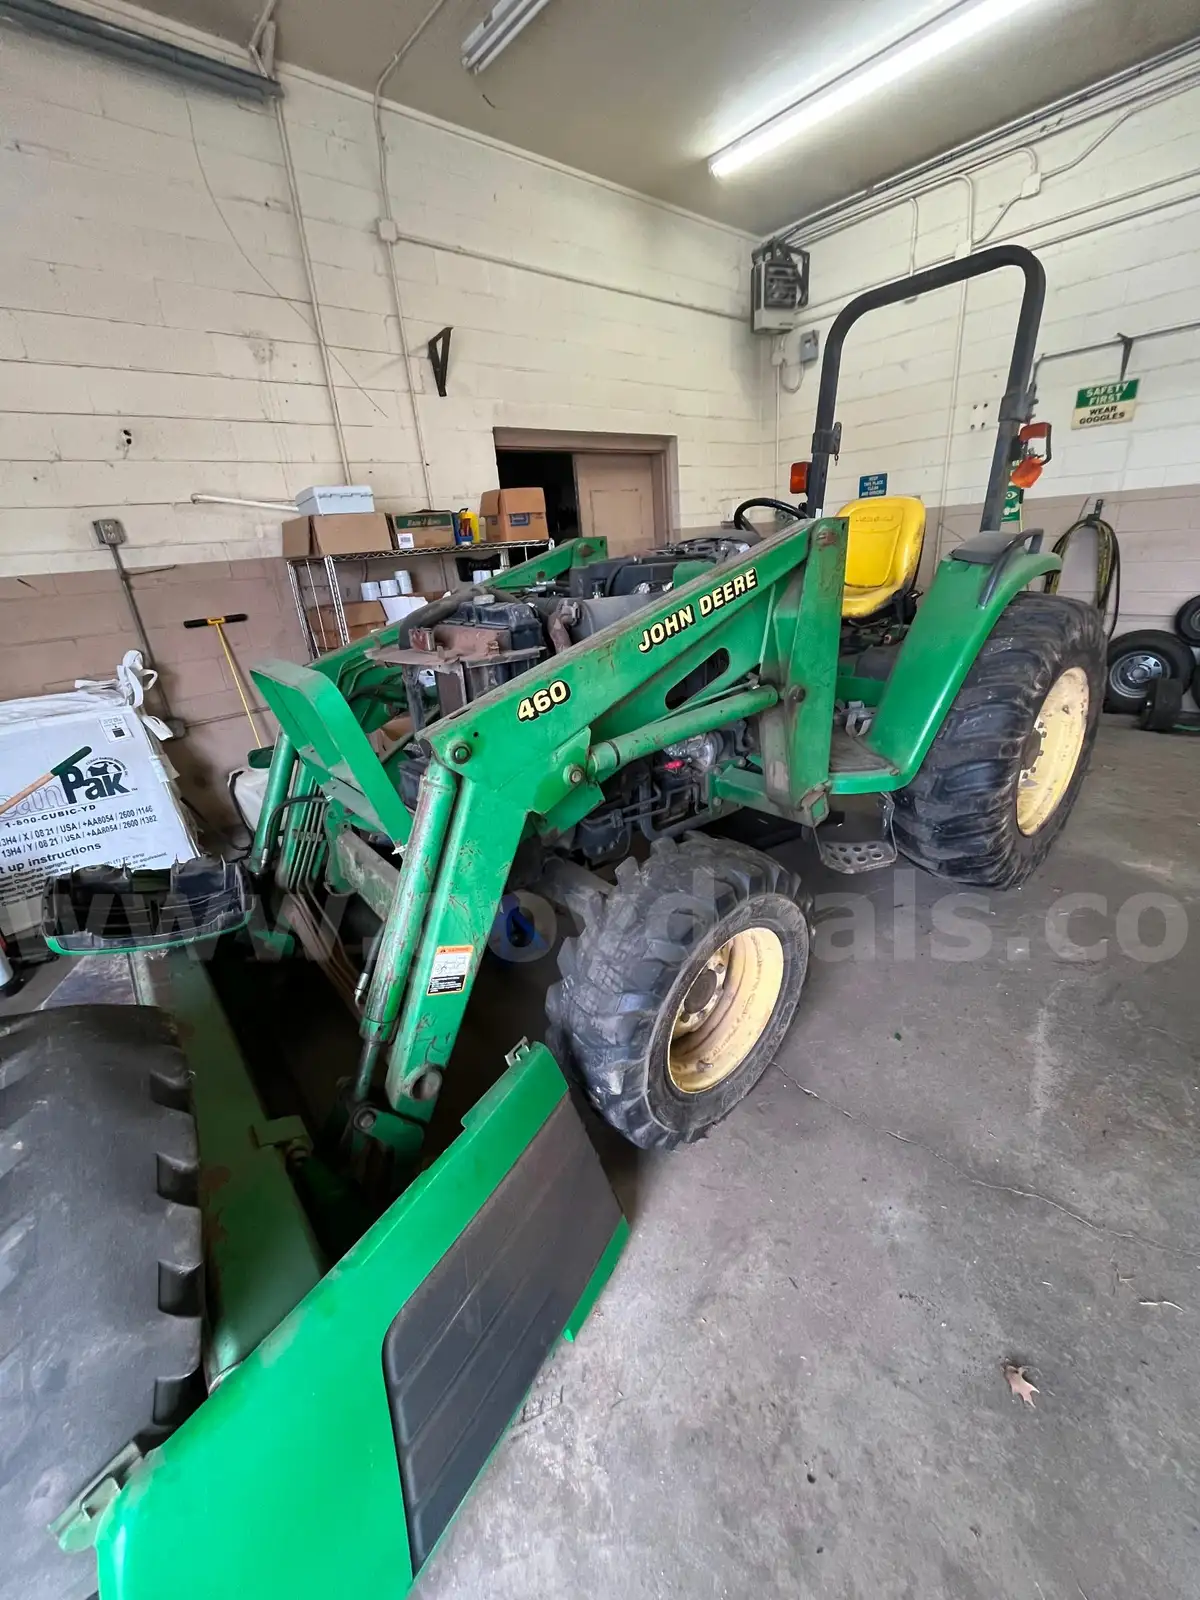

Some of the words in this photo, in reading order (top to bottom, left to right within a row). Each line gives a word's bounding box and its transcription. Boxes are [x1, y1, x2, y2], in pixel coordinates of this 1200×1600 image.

[1085, 380, 1129, 398] SAFETY
[1089, 393, 1122, 405] FIRST
[1079, 411, 1125, 424] GOGGLES
[1090, 405, 1117, 416] WEAR
[638, 603, 696, 653] JOHN
[699, 567, 758, 618] DEERE
[517, 680, 571, 722] 460
[5, 803, 97, 828] 1-800-CUBIC-YD
[60, 822, 78, 833] USA
[2, 845, 22, 858] 13H4
[26, 842, 33, 851] Y
[64, 833, 82, 843] USA
[7, 862, 25, 872] up
[27, 842, 102, 867] instructions
